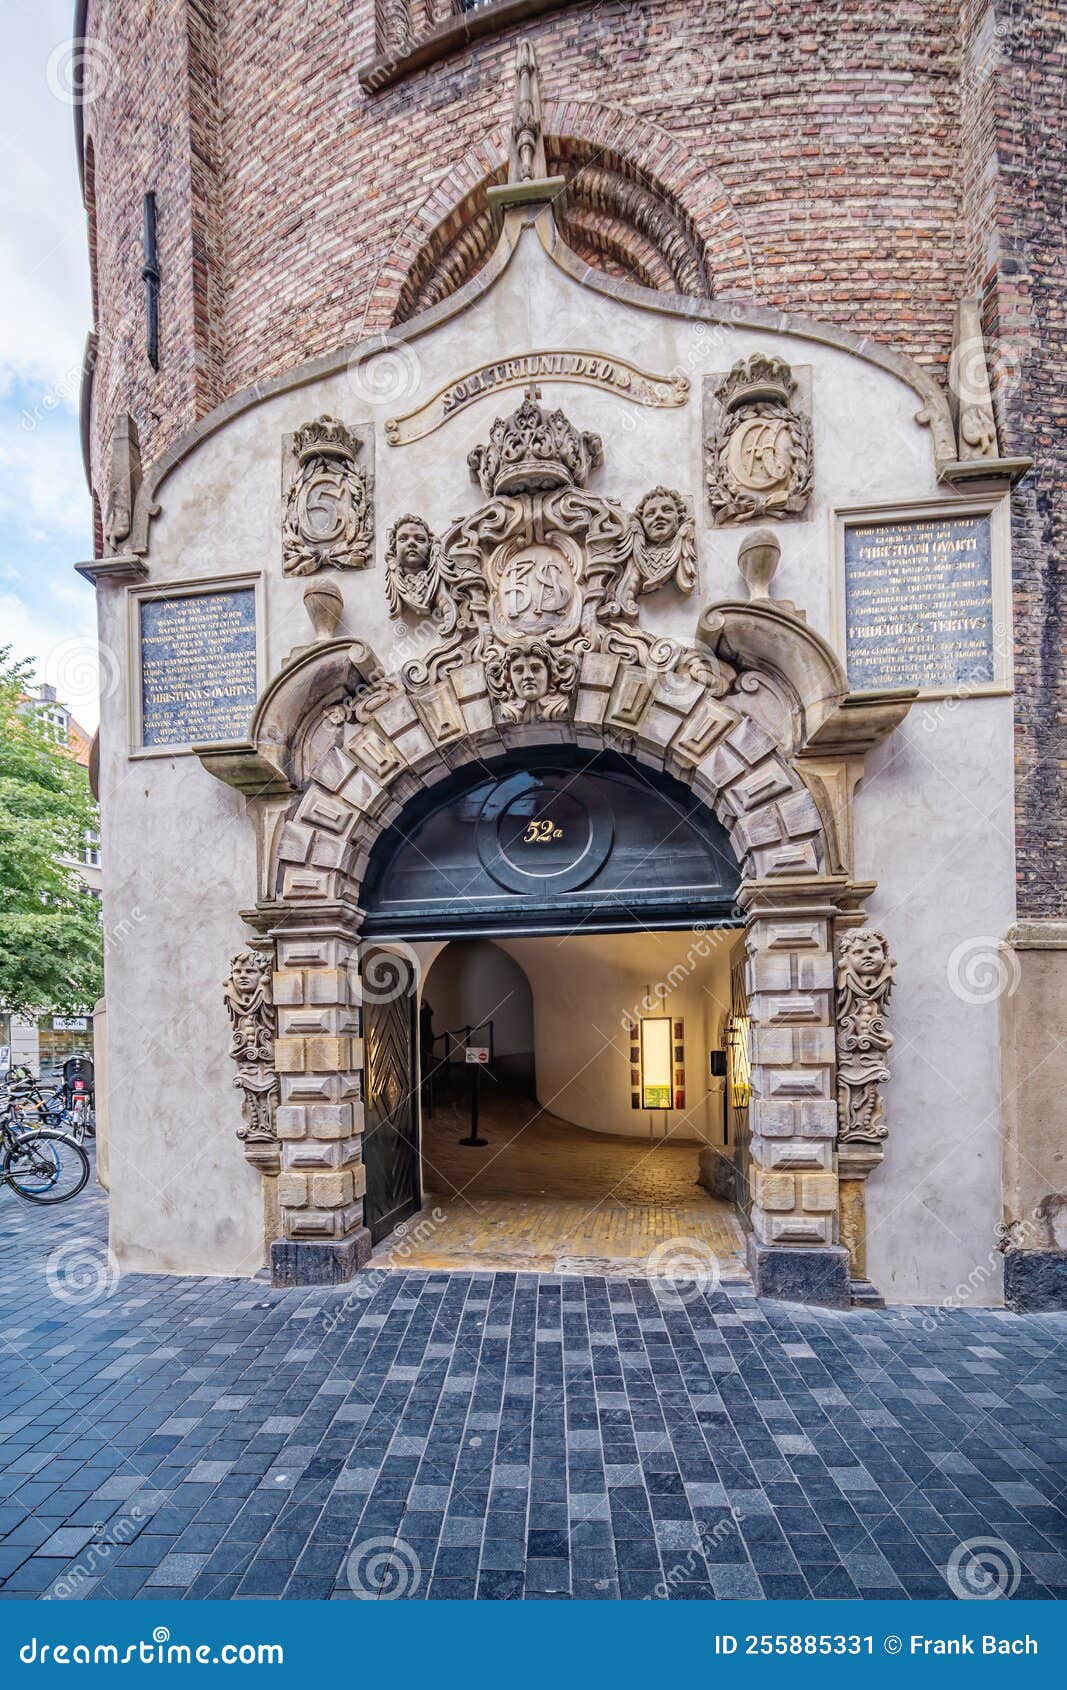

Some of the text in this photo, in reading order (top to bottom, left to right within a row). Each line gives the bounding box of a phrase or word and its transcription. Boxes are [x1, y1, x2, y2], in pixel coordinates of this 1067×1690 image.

[859, 538, 977, 559] CHRISTIANI QVARTI
[849, 622, 924, 639] FRIDERICVS
[930, 616, 986, 633] TERTIVS
[146, 689, 210, 705] CHRISTIANVS
[212, 684, 255, 698] QVARTVS
[523, 819, 564, 843] 52a
